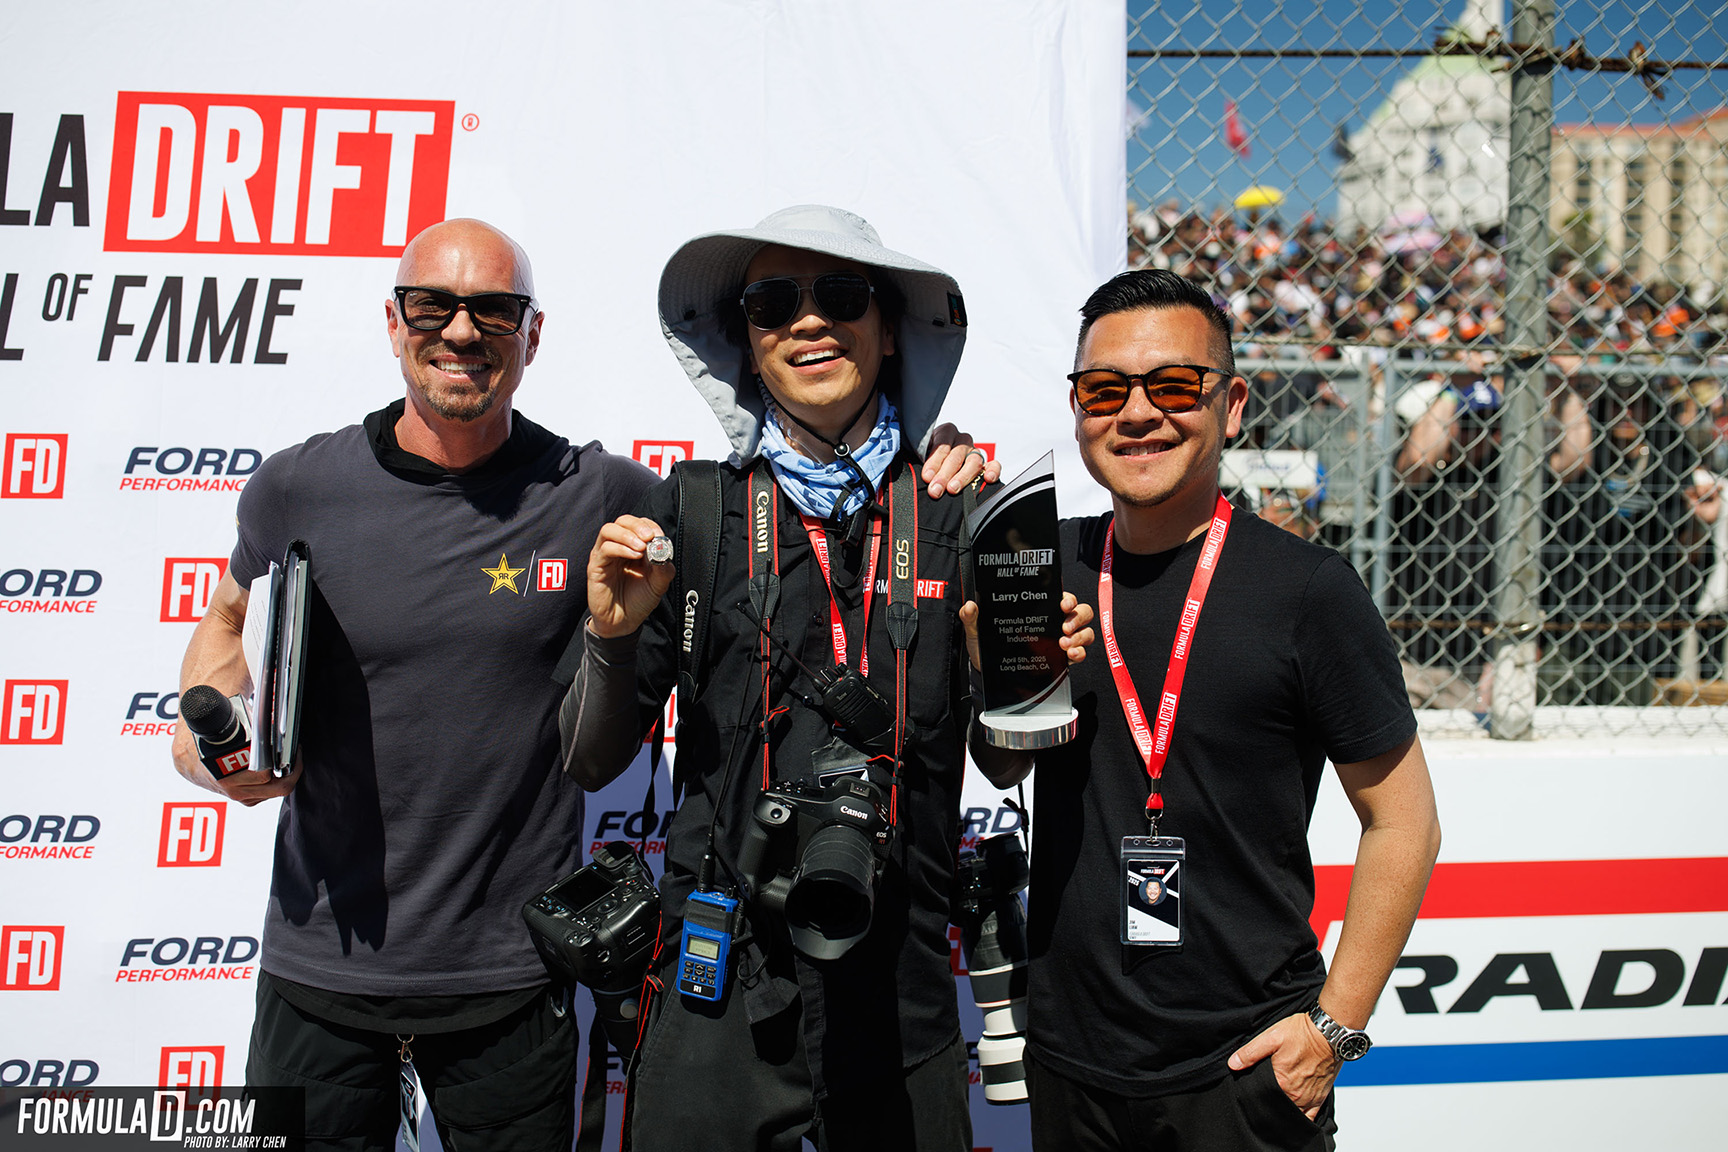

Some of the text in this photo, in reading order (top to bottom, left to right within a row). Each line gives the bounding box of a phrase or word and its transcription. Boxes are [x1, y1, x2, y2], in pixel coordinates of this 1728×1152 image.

[127, 103, 436, 246] DRIFT
[42, 273, 93, 321] OF
[97, 275, 303, 364] FAME
[10, 438, 60, 494] FD
[124, 447, 262, 475] FORD
[120, 478, 247, 491] PERFORMANC
[756, 490, 770, 553] Canon
[896, 540, 910, 579] EOS
[979, 550, 1051, 566] FORMULA DRIFT
[1201, 518, 1227, 570] FORMULA DRIFT
[541, 562, 564, 588] FD
[997, 567, 1014, 577] HALL
[1020, 566, 1040, 576] FAME
[169, 563, 220, 617] FD
[917, 581, 944, 598] RIFT
[992, 591, 1048, 602] Larry Chen
[683, 590, 699, 653] Canon
[994, 617, 1024, 625] Formula
[999, 626, 1013, 634] Hall
[1024, 625, 1045, 633] Fame
[1175, 600, 1200, 659] FORMULA DRIFT
[1006, 635, 1039, 643] Inductee
[1103, 611, 1122, 668] FORMULA DRIFT
[9, 685, 60, 739] FD
[126, 692, 179, 720] FO
[1125, 698, 1142, 732] FORMULA
[1155, 693, 1177, 754] FORMULA DRIFT
[222, 750, 250, 772] FD
[841, 806, 868, 820] Canon
[964, 807, 1022, 833] RD
[166, 807, 218, 862] FD
[6, 931, 56, 985] FD
[120, 936, 259, 966] FORD
[115, 967, 254, 982] PERFORMANCE
[1395, 947, 1728, 1014] RADI
